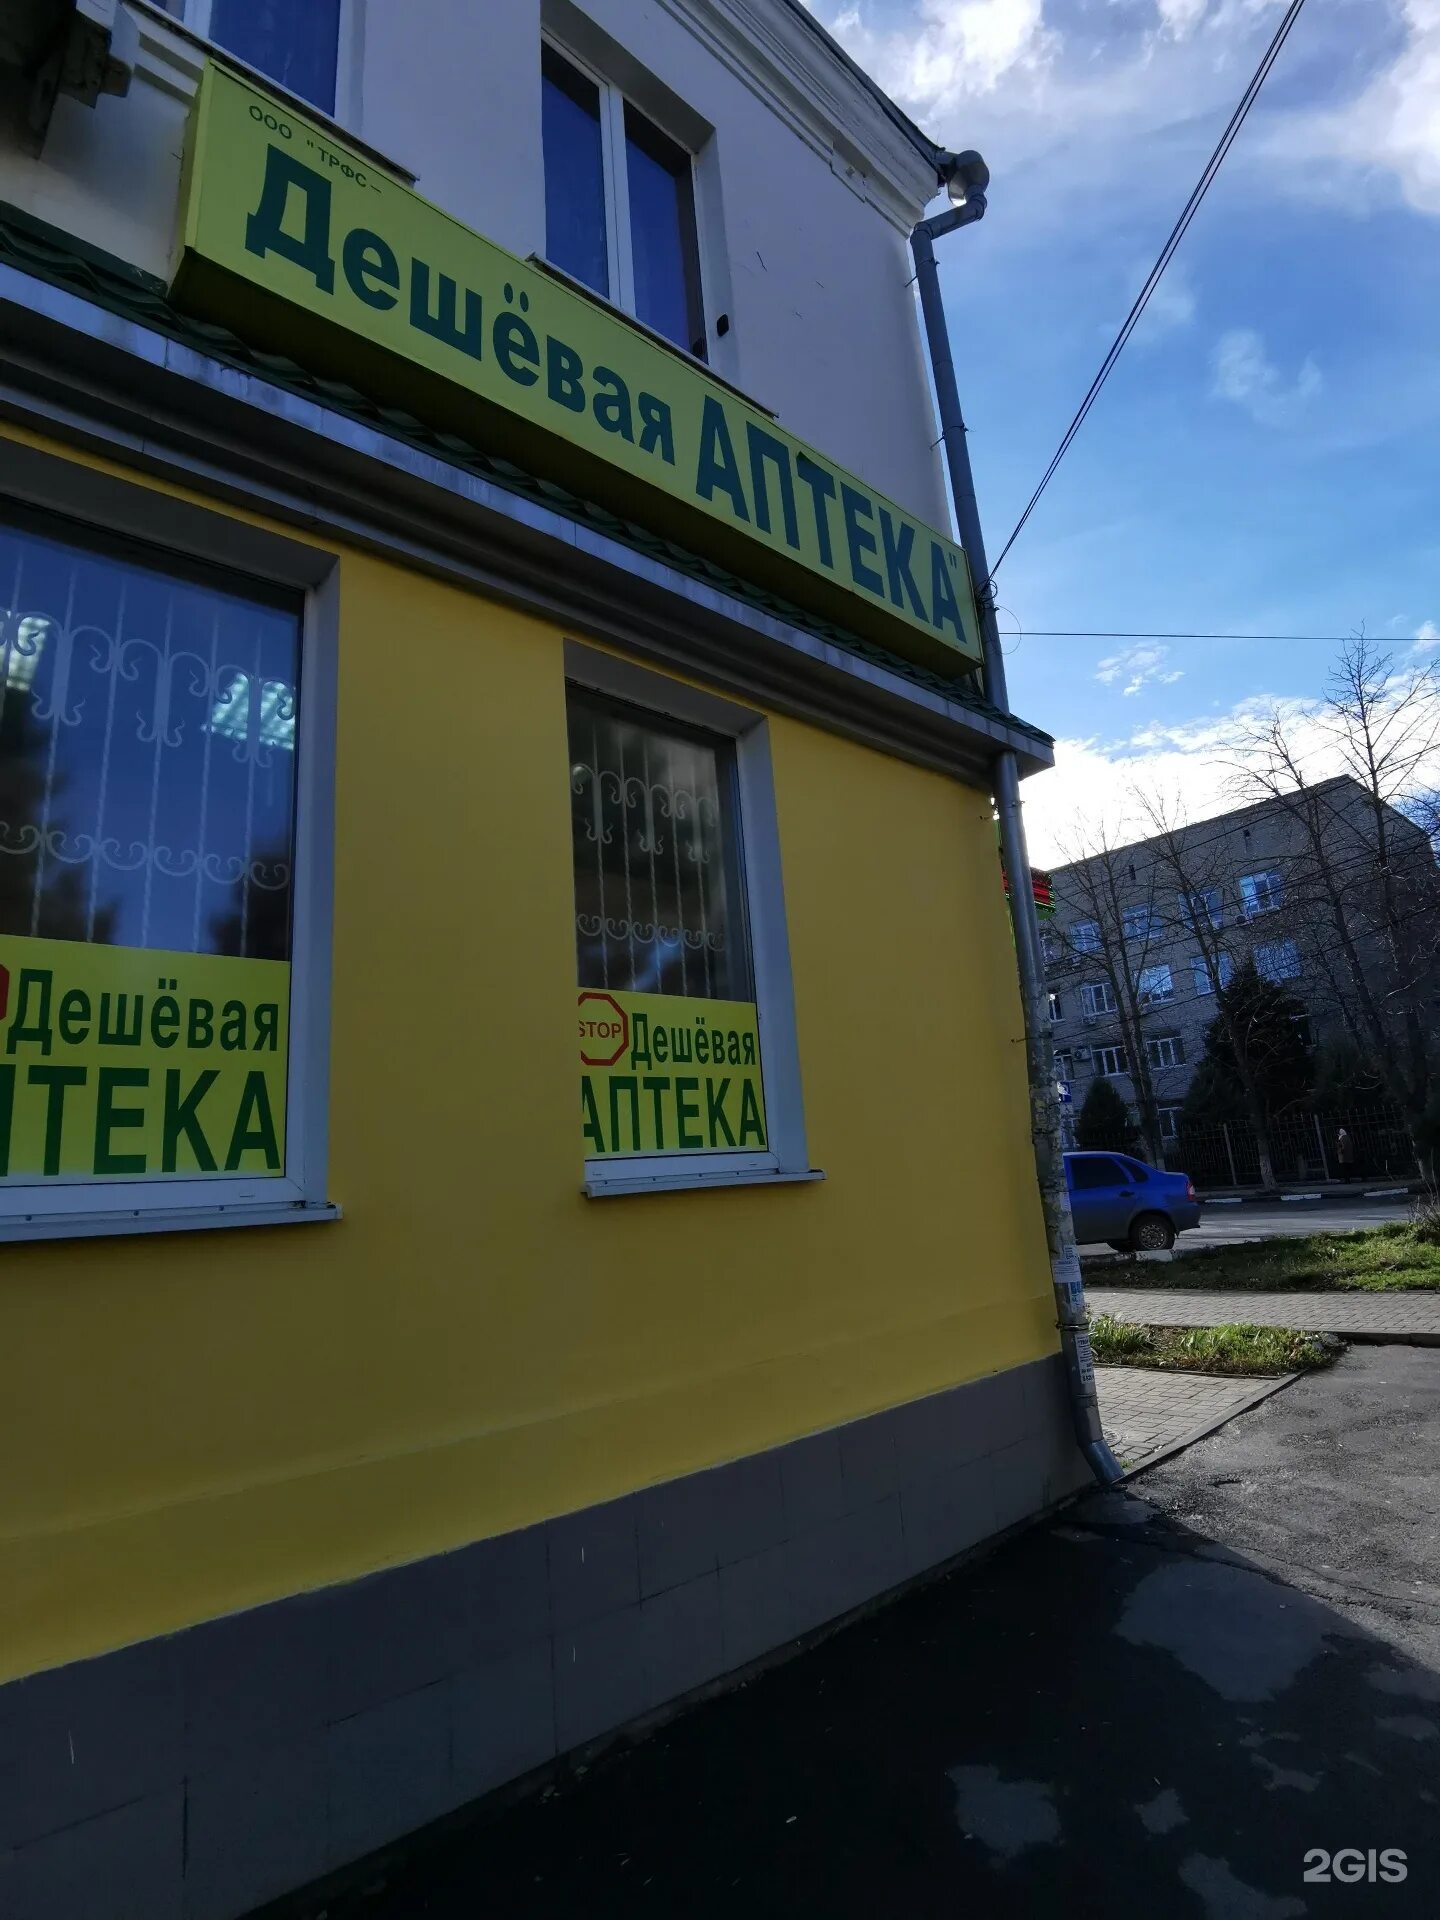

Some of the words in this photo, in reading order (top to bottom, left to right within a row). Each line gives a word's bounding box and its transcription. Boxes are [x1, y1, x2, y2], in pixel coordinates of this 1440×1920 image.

[249, 105, 293, 140] ООО
[244, 143, 676, 466] Дешёвая
[695, 394, 967, 644] АПТЕКА"
[6, 967, 279, 1056] Дешёвая
[630, 1012, 756, 1071] Дешёвая
